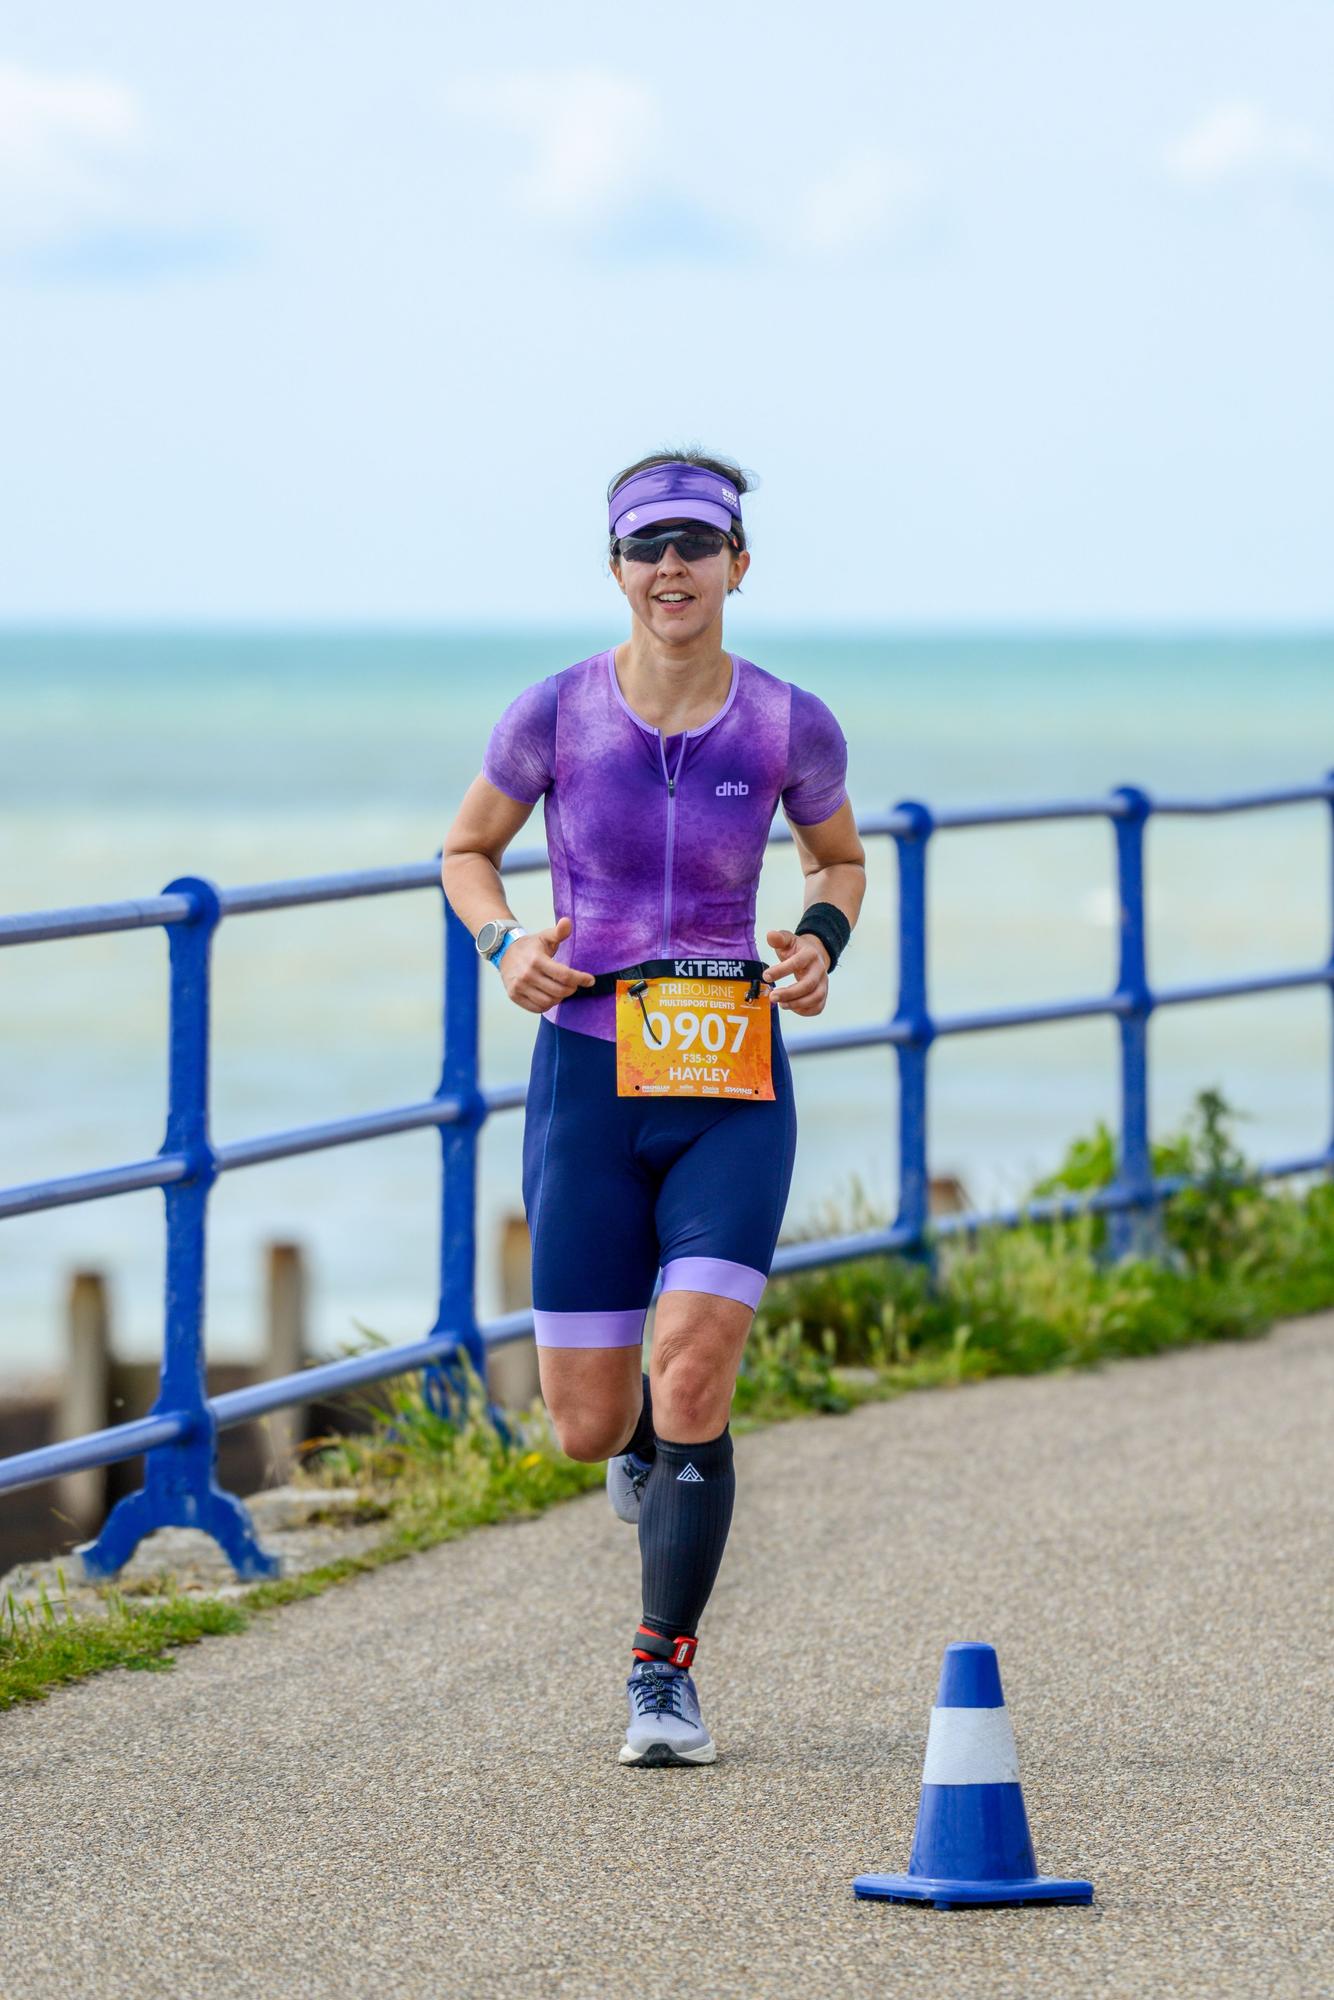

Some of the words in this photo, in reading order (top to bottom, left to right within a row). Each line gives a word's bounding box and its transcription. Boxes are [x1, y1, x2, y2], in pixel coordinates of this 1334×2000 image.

[715, 781, 749, 796] dhb
[660, 983, 735, 998] TRIBOURNE
[659, 999, 708, 1008] MULTISPORT
[710, 1001, 735, 1010] EVENTS
[642, 1011, 749, 1053] 0907
[683, 1054, 718, 1064] F35-39
[669, 1067, 730, 1082] HAYLEY
